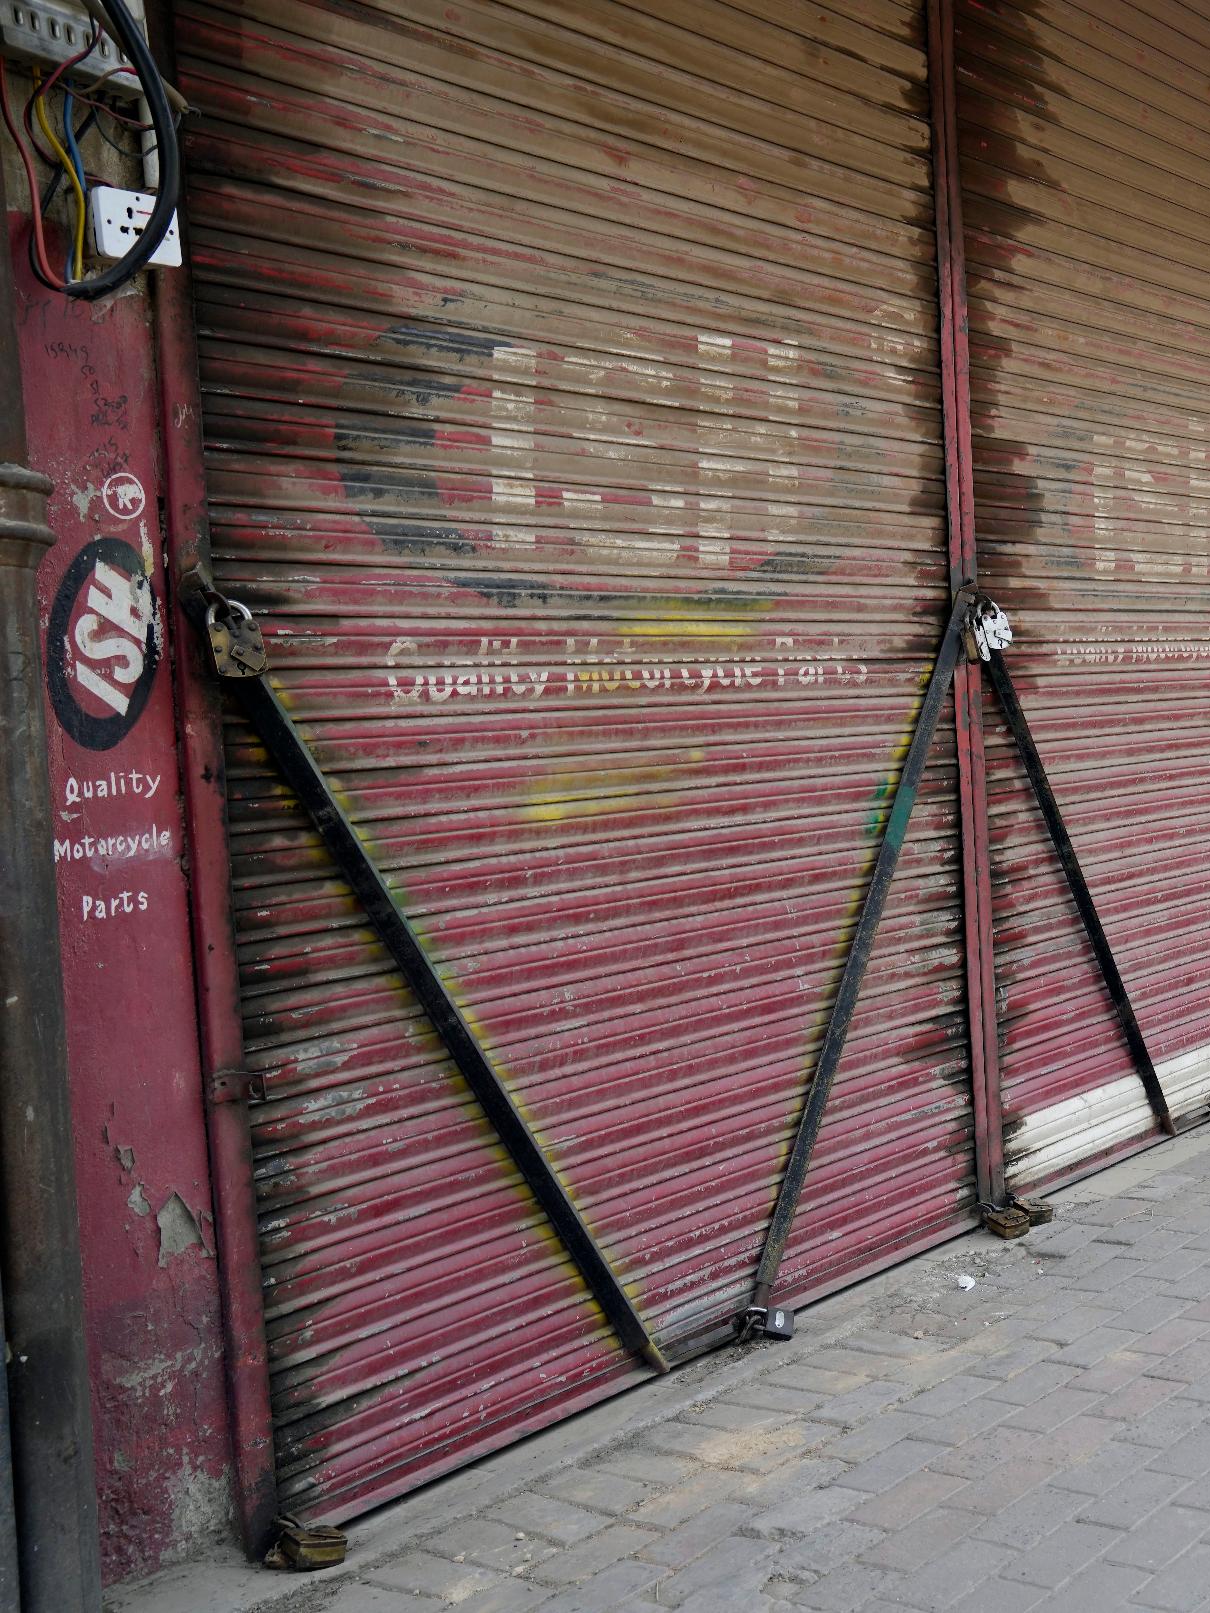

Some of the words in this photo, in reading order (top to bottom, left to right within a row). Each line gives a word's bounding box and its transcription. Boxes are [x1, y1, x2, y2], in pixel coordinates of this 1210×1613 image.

[75, 558, 150, 716] ISH
[386, 637, 549, 704] Quality
[775, 637, 868, 686] Parts
[65, 769, 161, 806] Quality
[53, 829, 171, 863] Motorcycle
[82, 889, 148, 921] Parts
